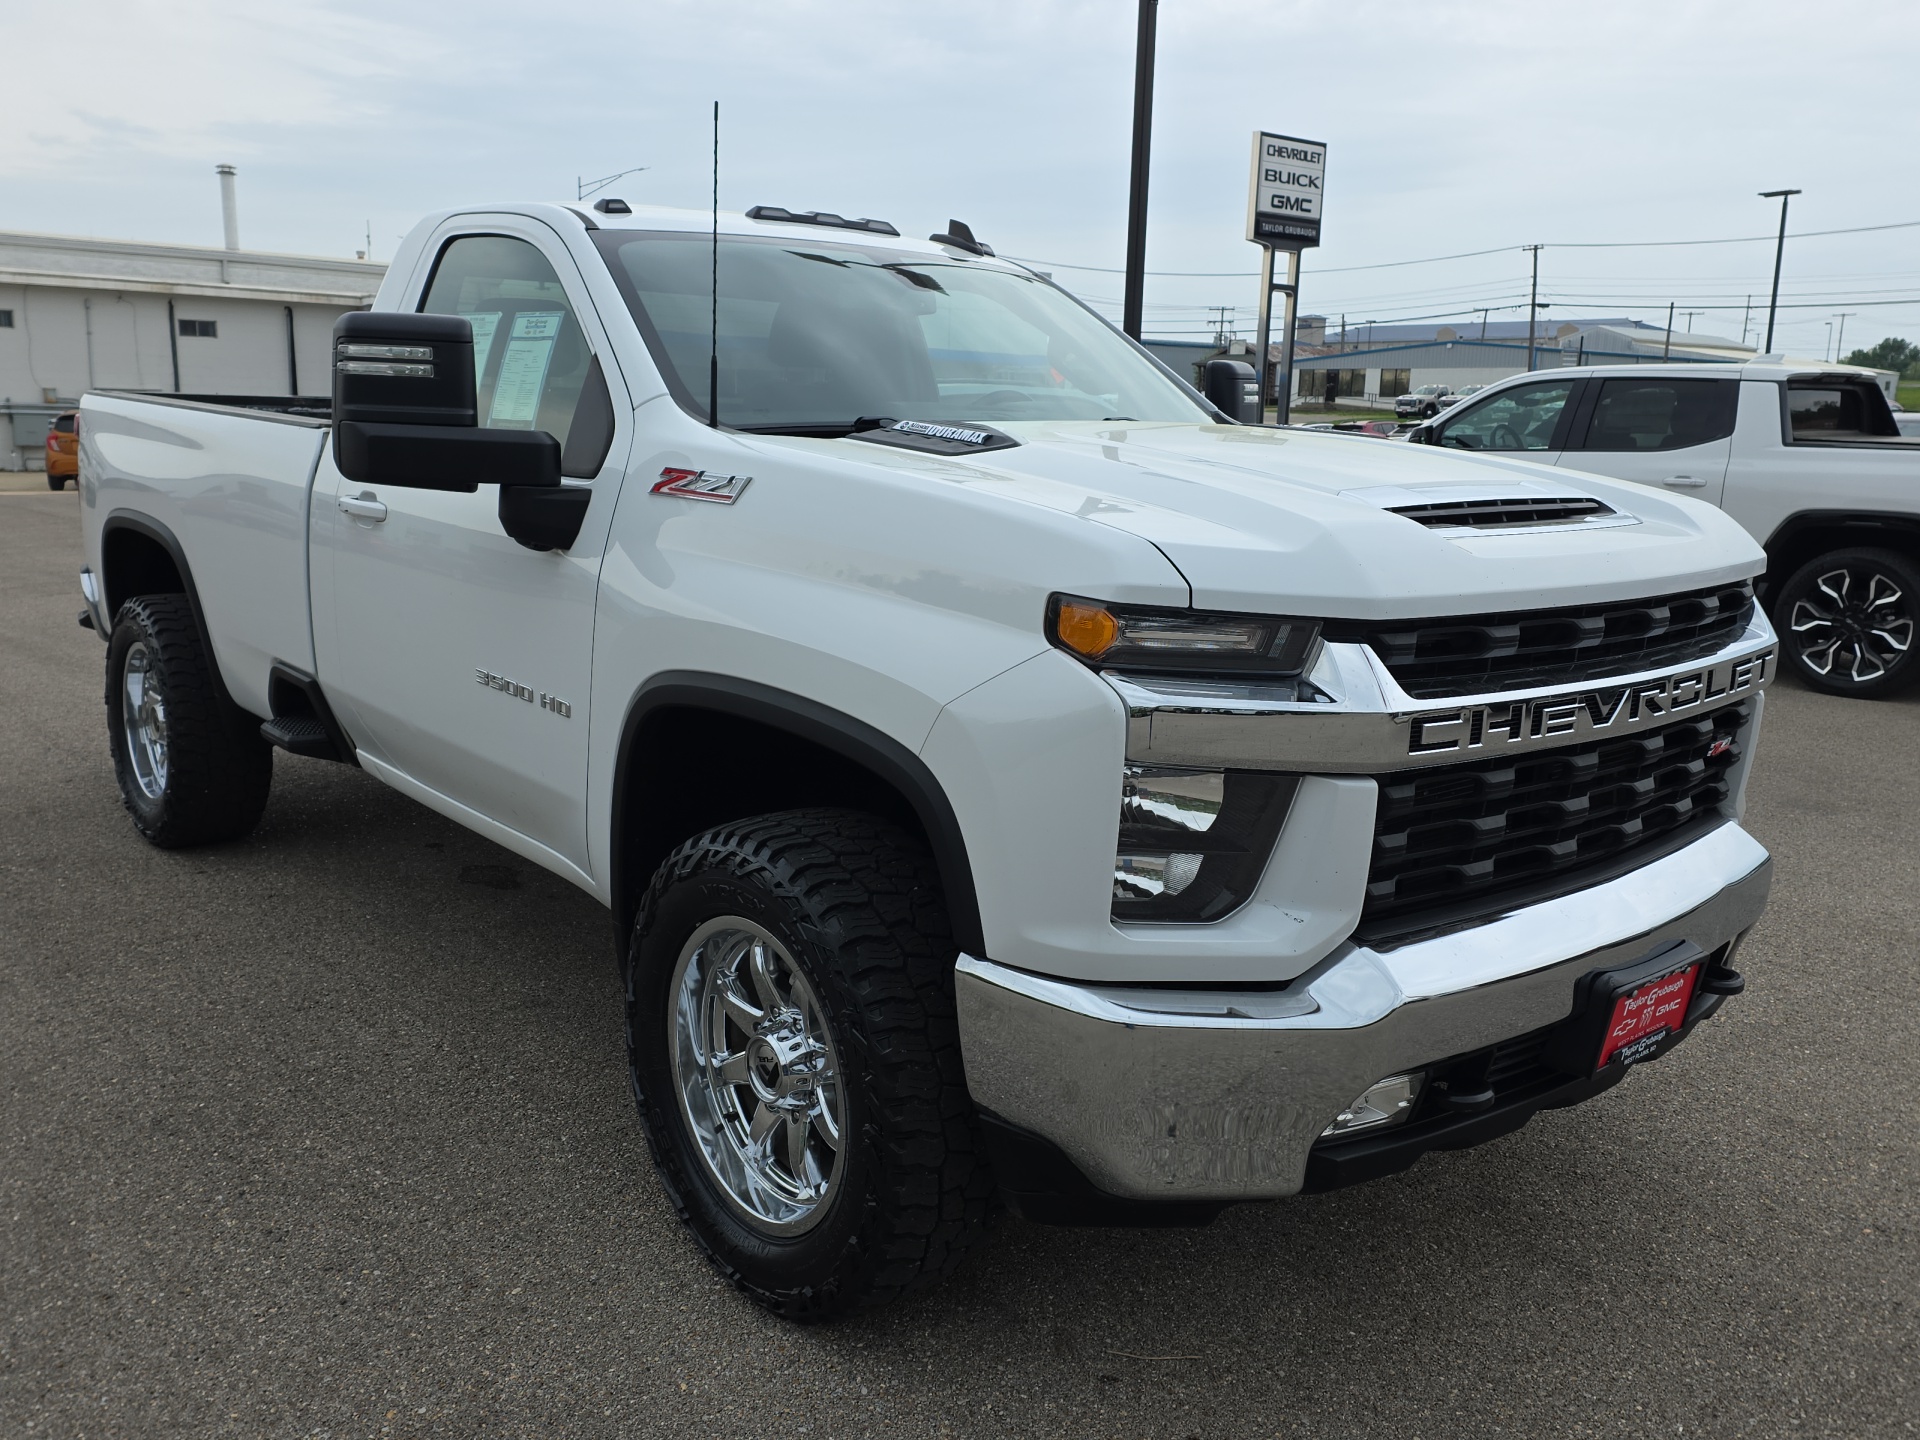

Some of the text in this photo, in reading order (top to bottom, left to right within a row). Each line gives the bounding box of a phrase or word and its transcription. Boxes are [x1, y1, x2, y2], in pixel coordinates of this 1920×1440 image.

[1266, 143, 1322, 164] CHEVROLET
[1264, 168, 1320, 189] BUICK
[1271, 193, 1312, 213] GMC
[1262, 222, 1284, 233] TAYLOR
[928, 425, 987, 444] DURAMAX
[647, 466, 753, 506] Z71
[475, 667, 572, 719] 3500 HD
[1408, 648, 1775, 756] CHEVROLET
[1656, 999, 1681, 1016] GMC
